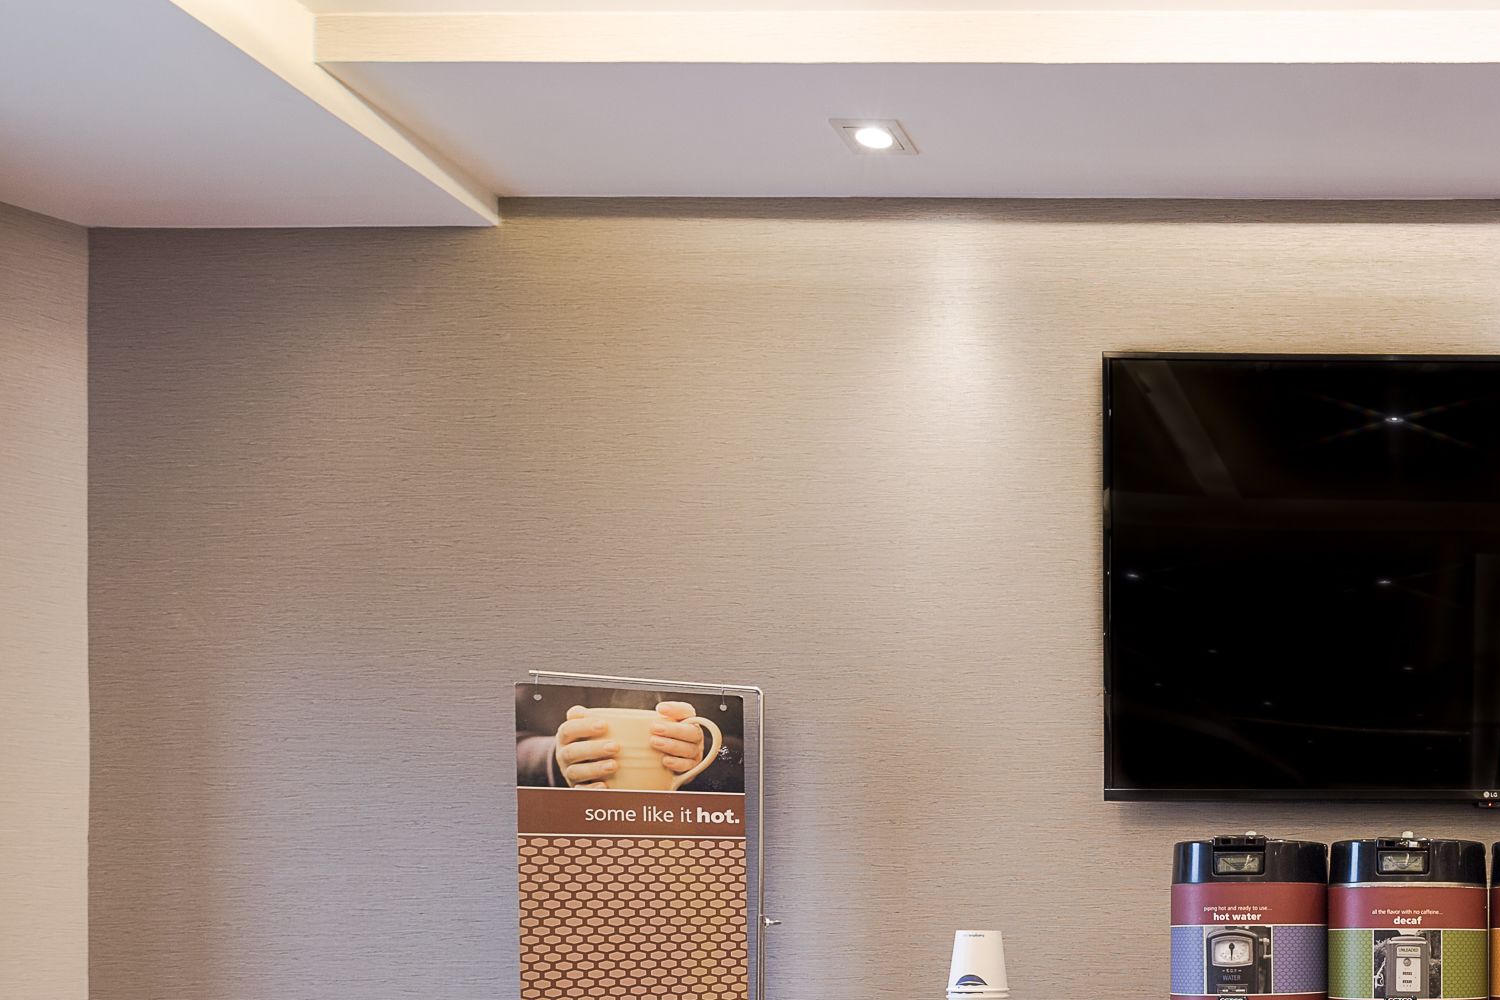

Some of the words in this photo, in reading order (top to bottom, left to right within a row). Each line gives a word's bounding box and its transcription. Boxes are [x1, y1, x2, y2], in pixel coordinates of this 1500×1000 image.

[584, 808, 637, 822] some
[643, 805, 674, 823] like
[680, 807, 692, 823] it
[696, 807, 740, 824] hot.
[1213, 912, 1230, 921] hot
[1231, 913, 1262, 921] water
[1393, 916, 1422, 925] decaf
